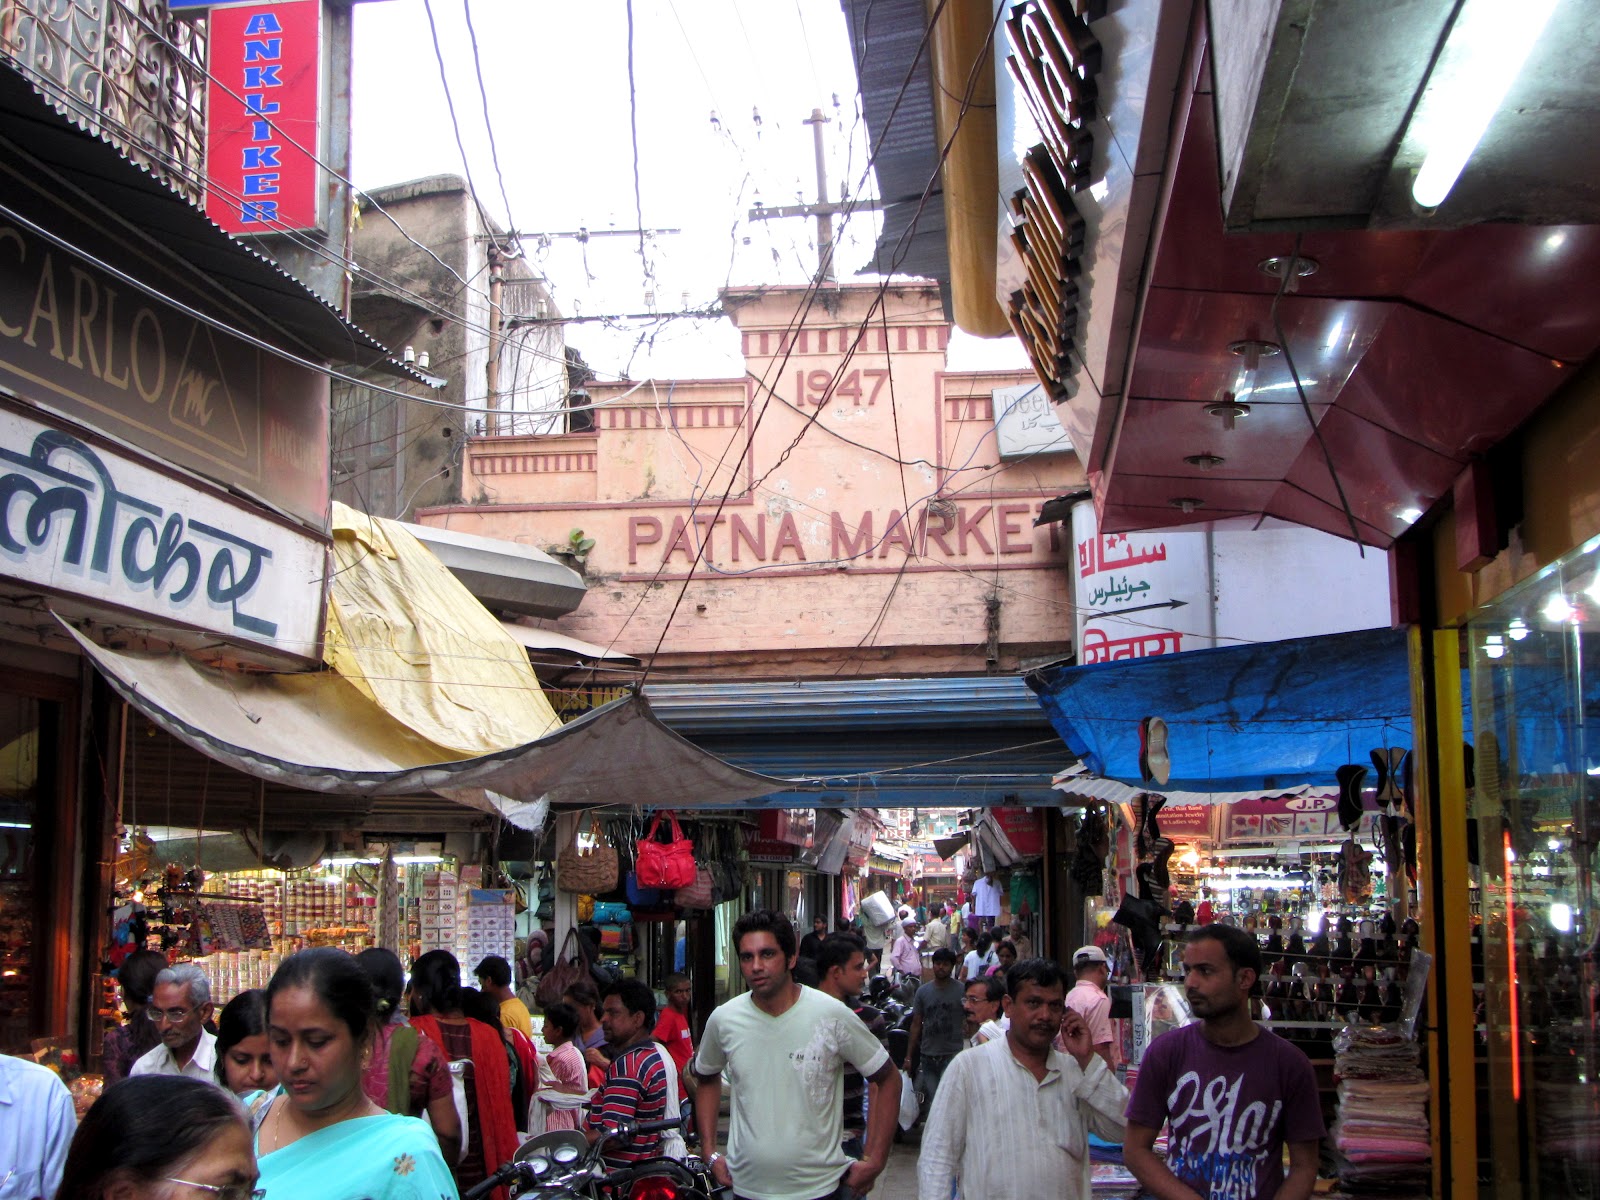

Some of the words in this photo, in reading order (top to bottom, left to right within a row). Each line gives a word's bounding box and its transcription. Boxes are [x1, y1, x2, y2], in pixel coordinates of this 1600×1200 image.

[240, 13, 283, 223] ANKLIKER
[796, 368, 889, 406] 1947
[628, 513, 806, 564] PATNA
[1296, 799, 1326, 810] J.P.
